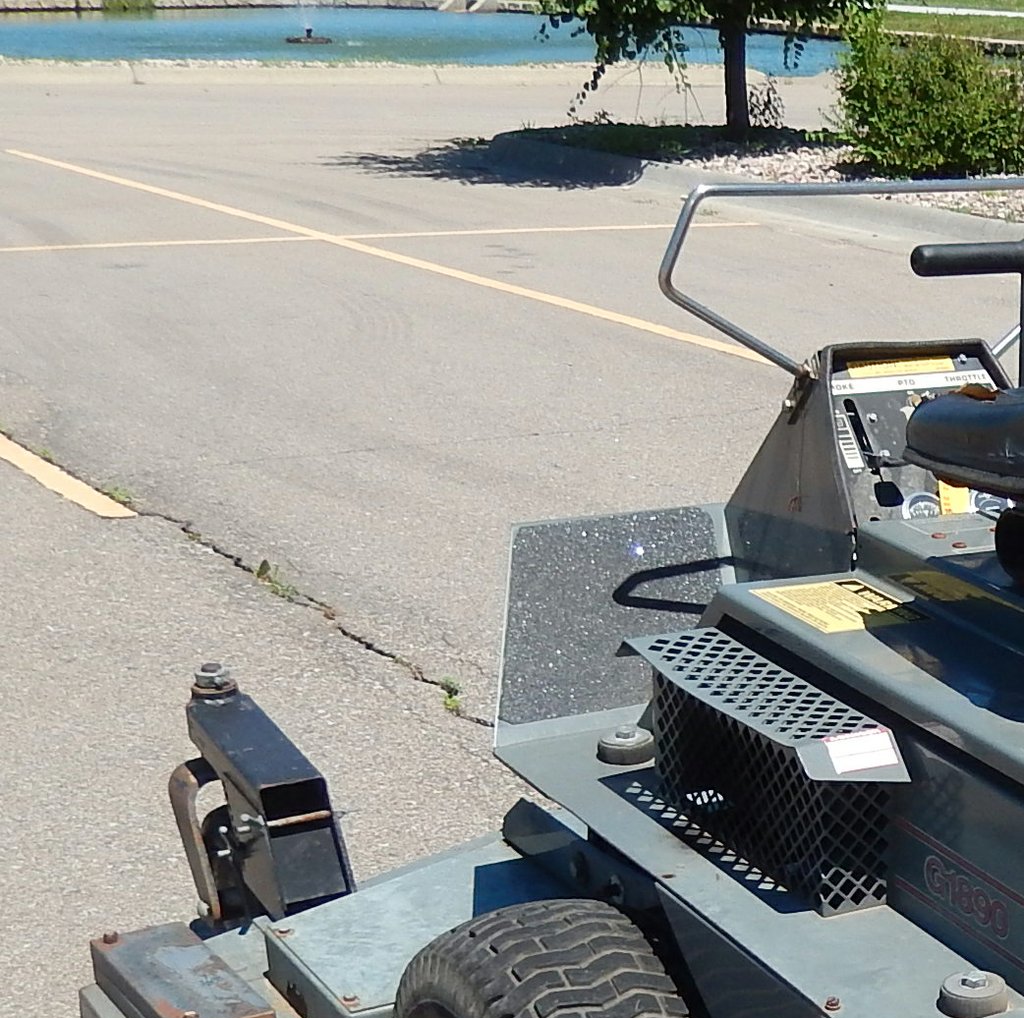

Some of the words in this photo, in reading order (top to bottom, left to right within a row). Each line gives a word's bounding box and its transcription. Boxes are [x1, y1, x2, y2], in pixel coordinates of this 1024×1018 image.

[944, 373, 986, 383] THROTTLE
[832, 383, 854, 391] OKE
[898, 379, 916, 387] PTO
